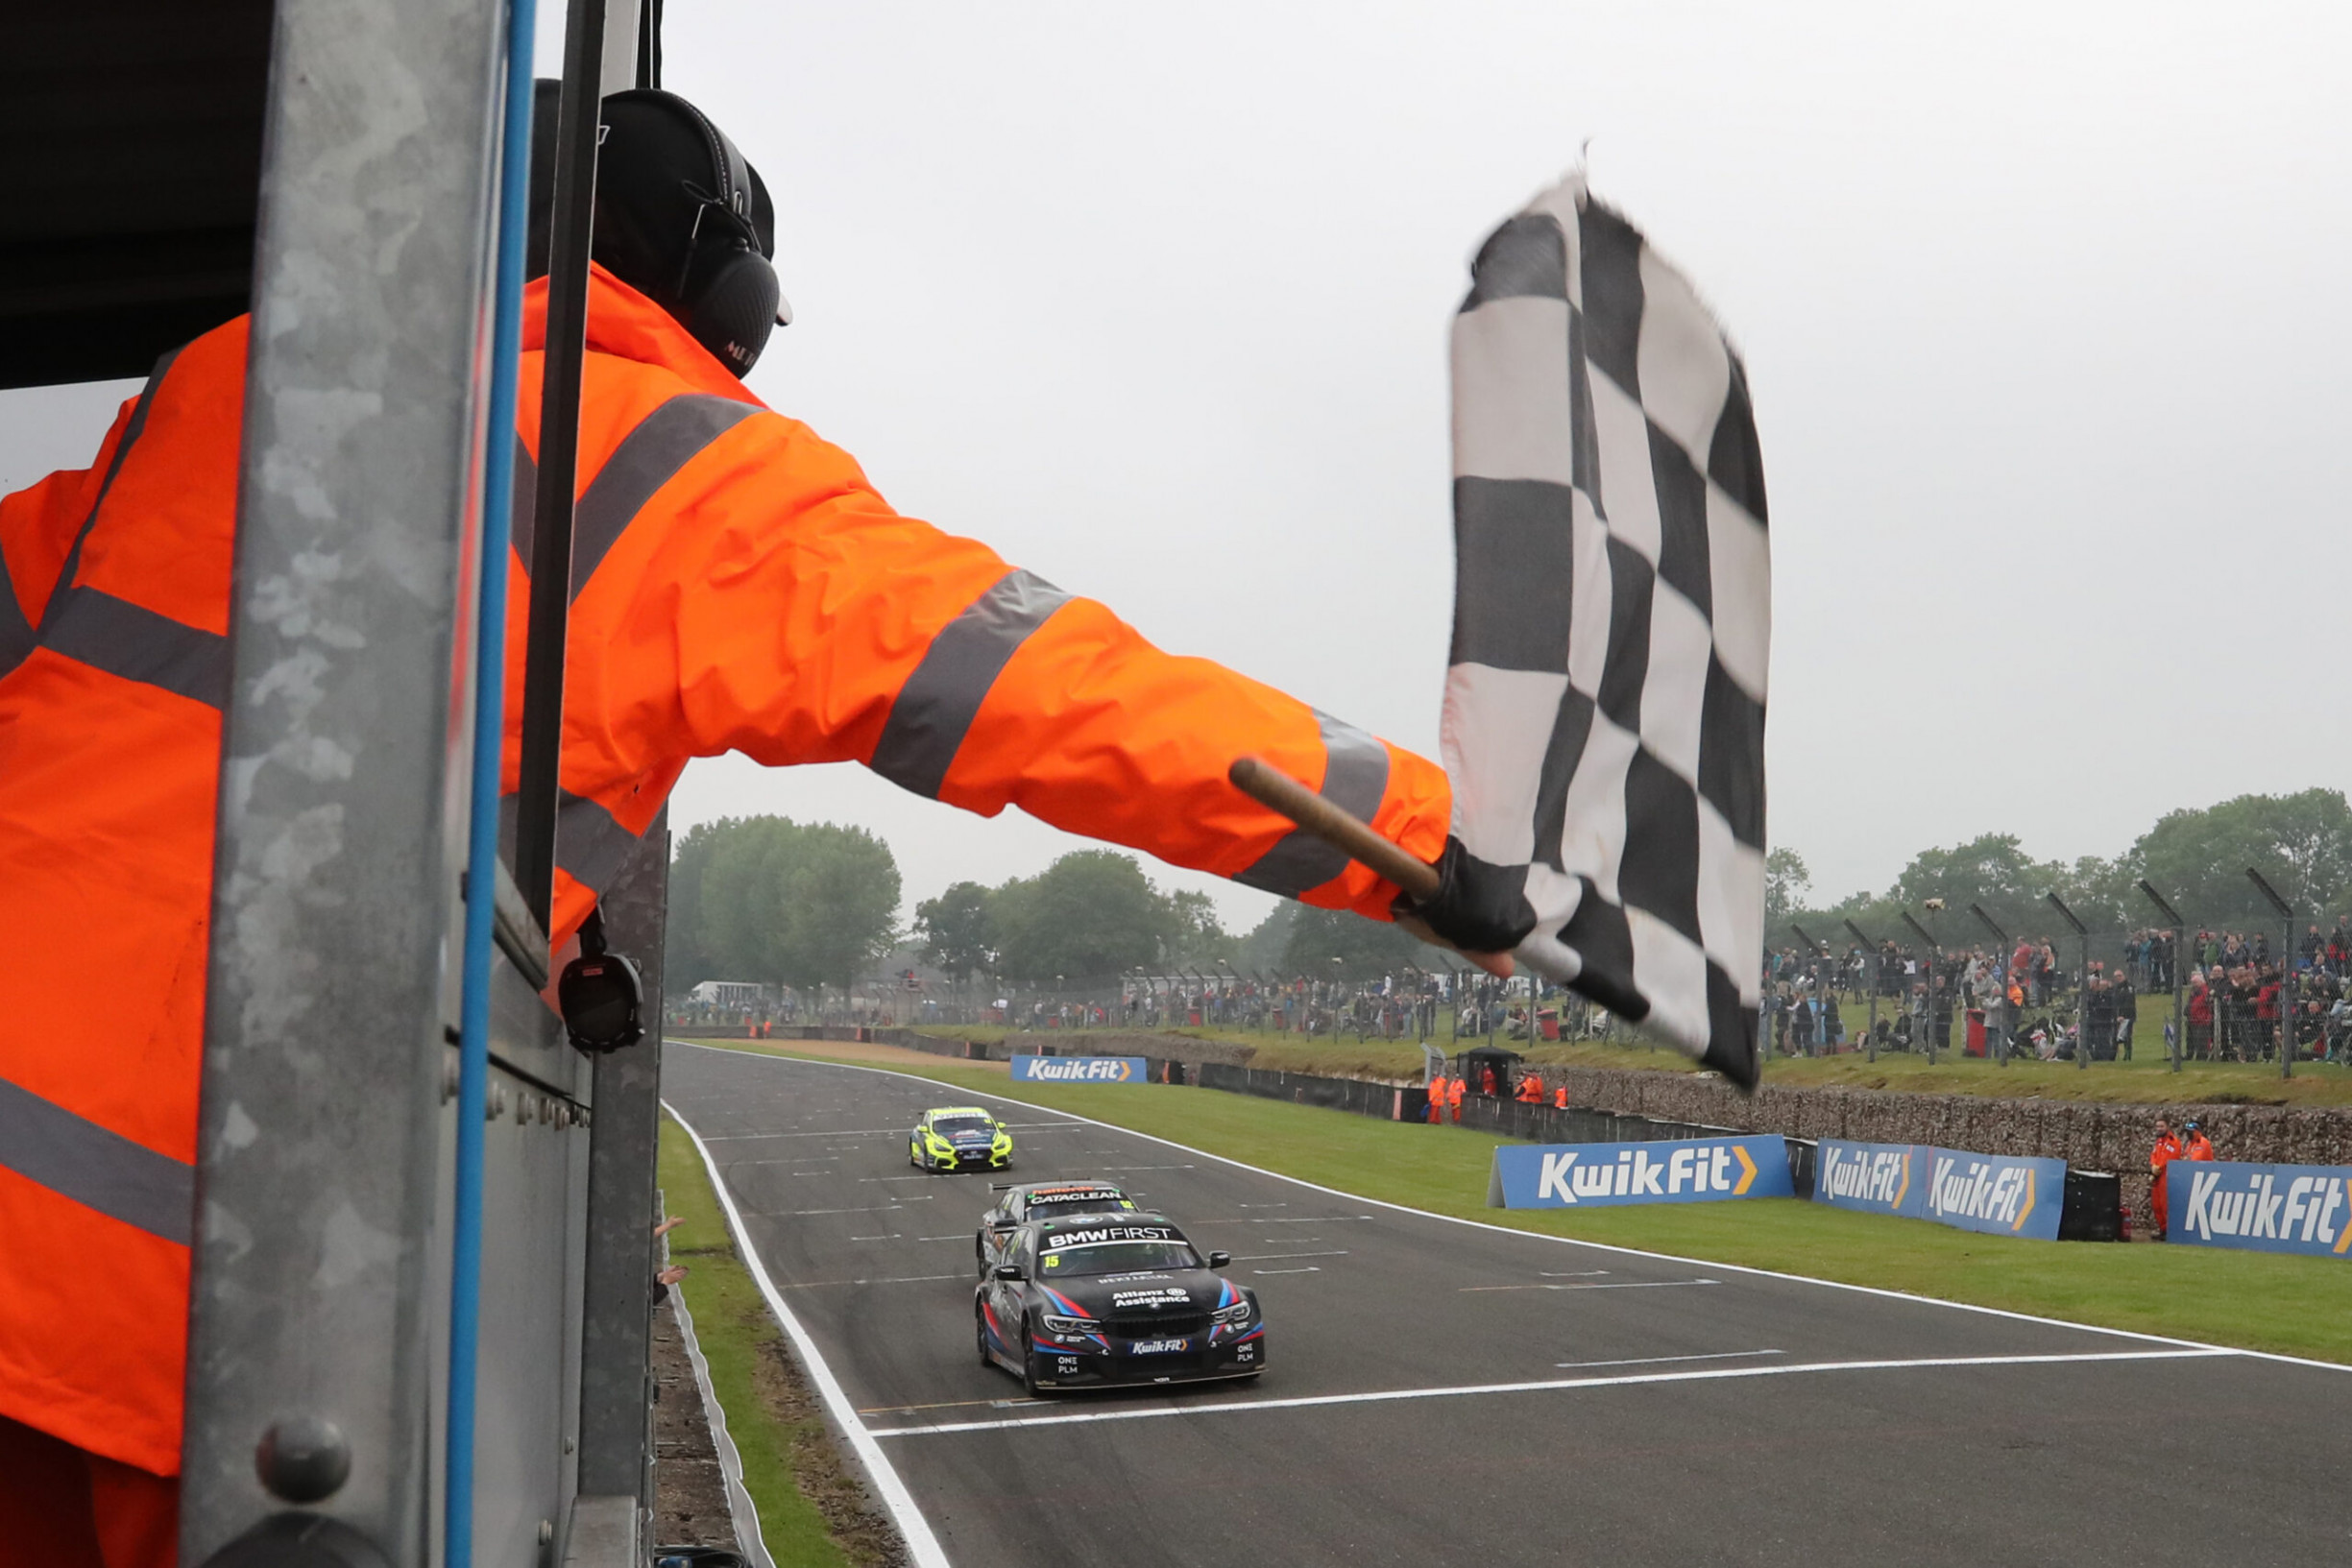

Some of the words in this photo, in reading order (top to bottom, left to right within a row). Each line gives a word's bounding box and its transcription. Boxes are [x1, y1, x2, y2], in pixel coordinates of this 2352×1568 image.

[1031, 1192, 1123, 1205] CATACLEAN
[1044, 1255, 1059, 1267] 15
[1112, 1289, 1165, 1300] Allianz
[1115, 1295, 1191, 1308] Assistance
